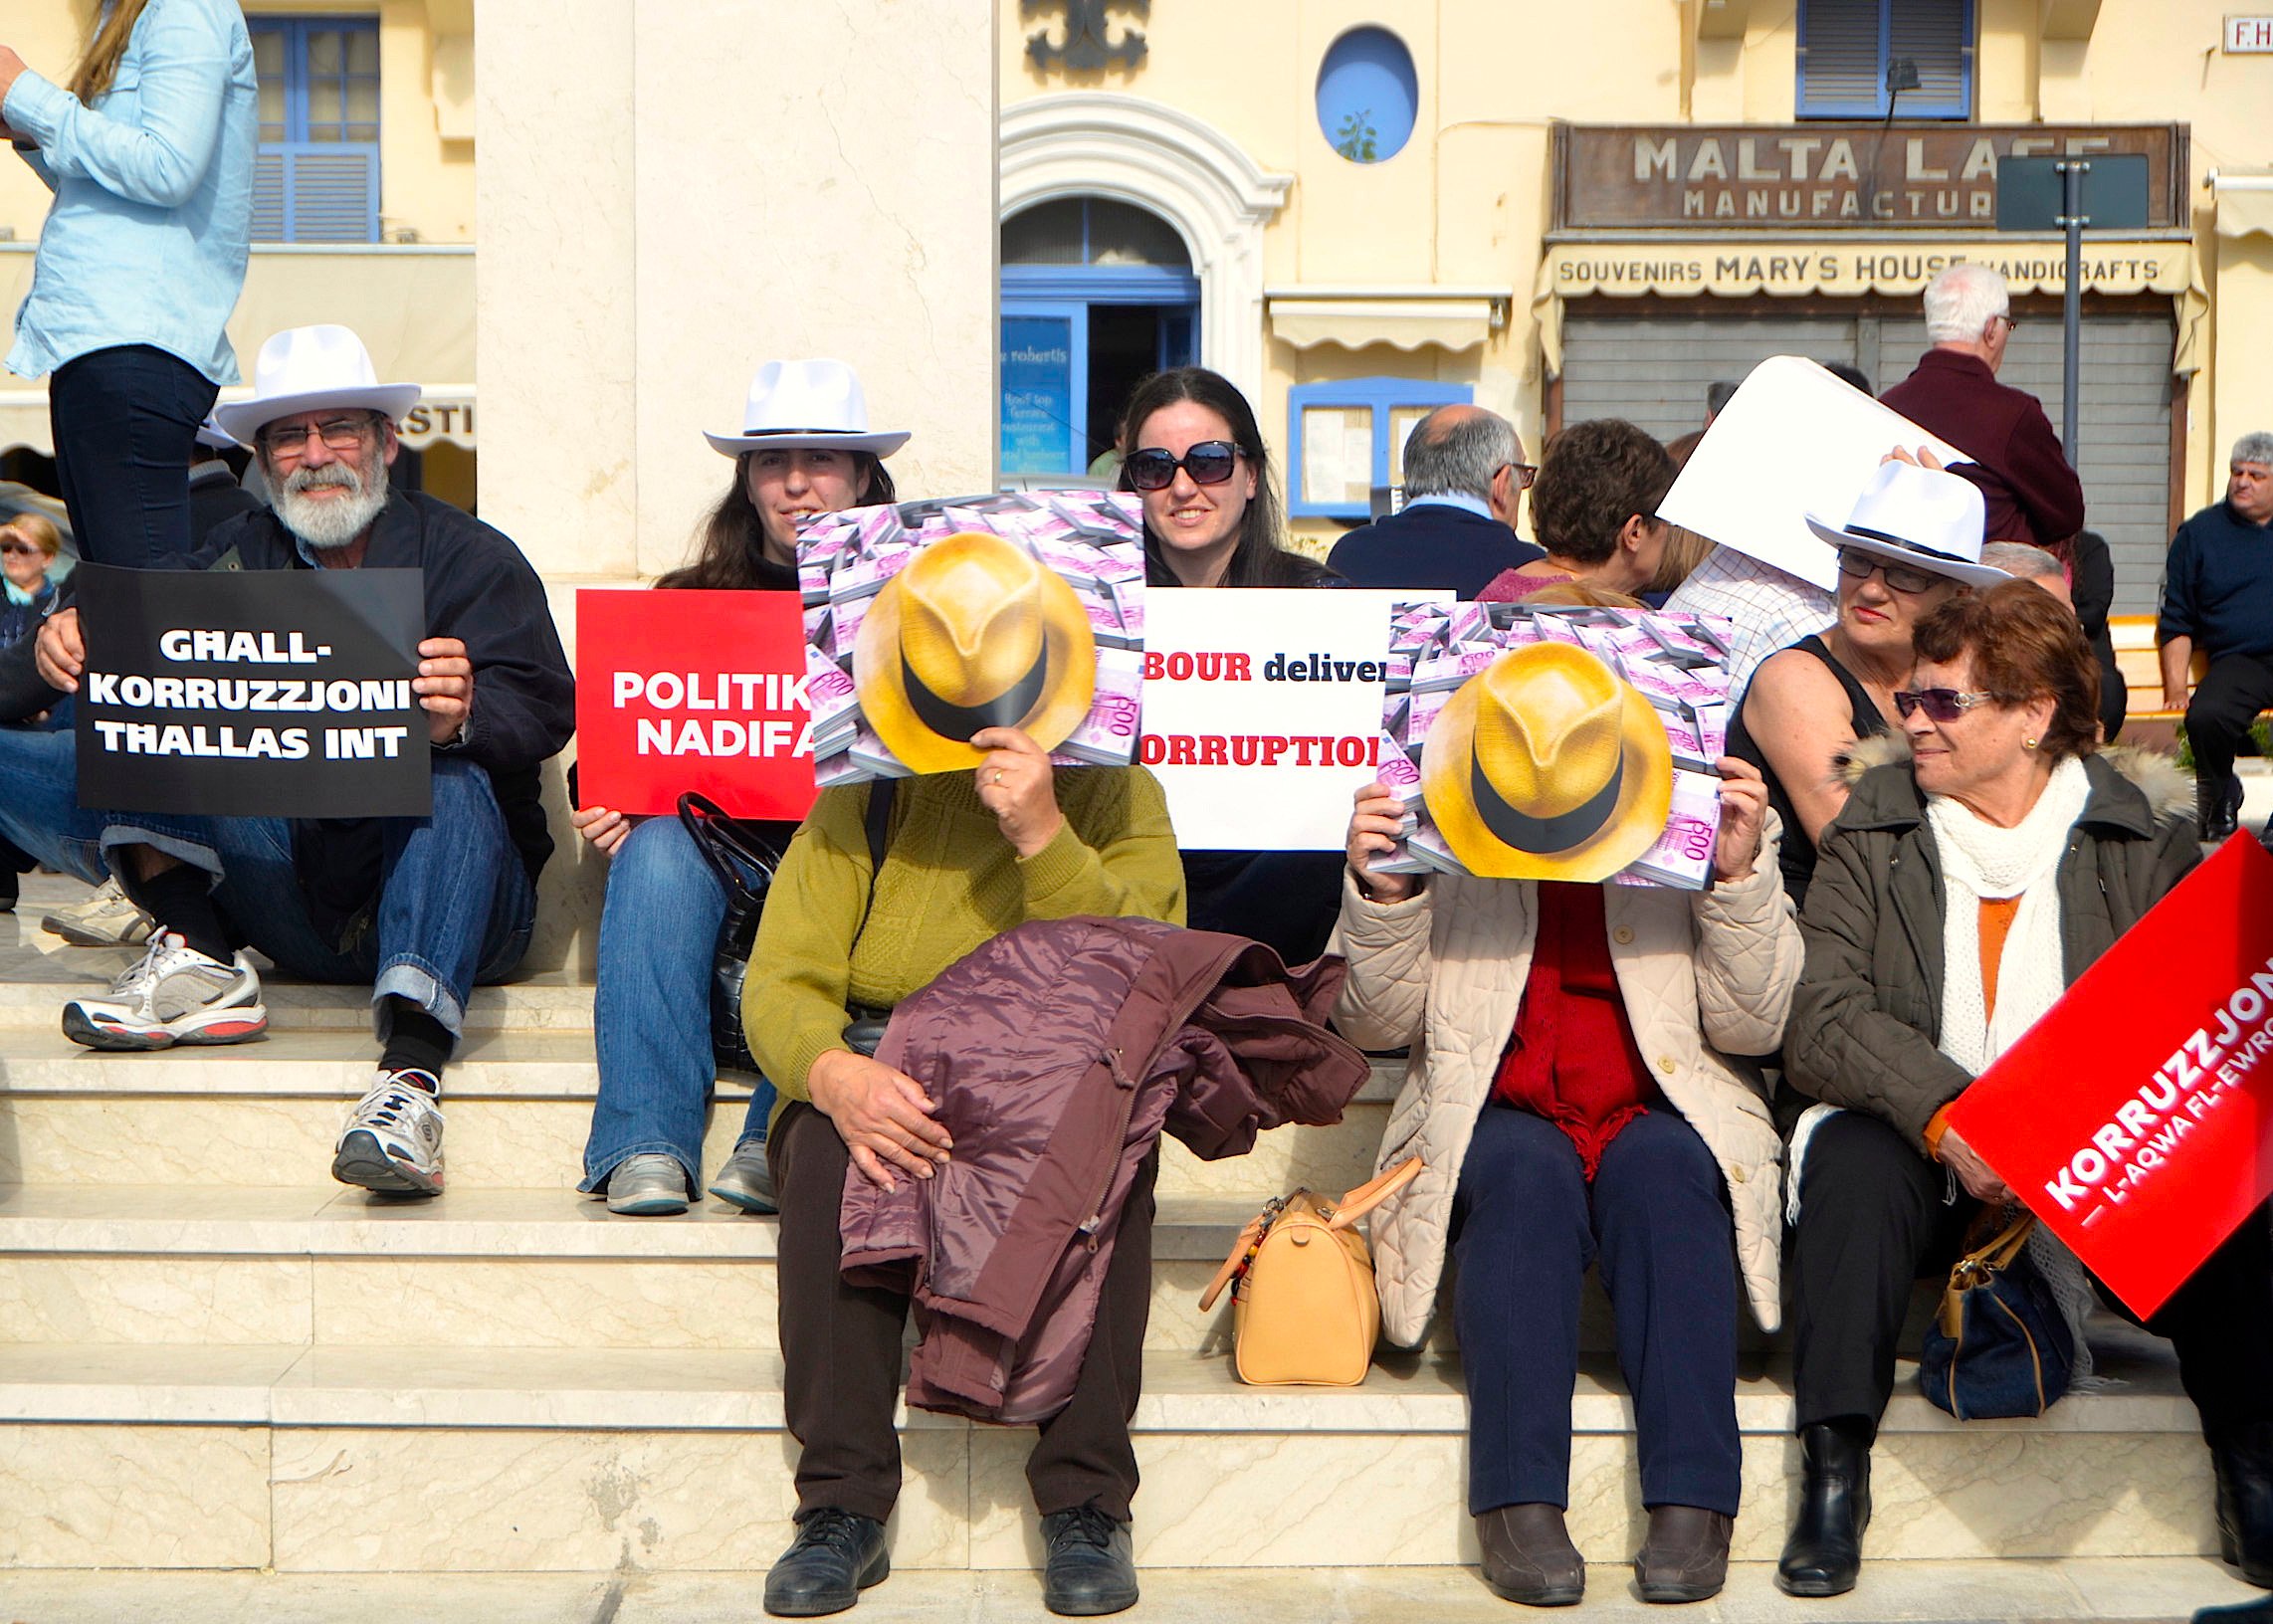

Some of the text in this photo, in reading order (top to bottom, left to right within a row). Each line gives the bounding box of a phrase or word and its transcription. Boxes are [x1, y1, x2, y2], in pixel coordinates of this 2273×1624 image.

[1633, 137, 1859, 180] MALTA
[1559, 261, 1702, 282] SOUVENIRS
[1715, 255, 1839, 282] MARY'S
[396, 404, 472, 435] STI
[1143, 652, 1252, 681] BOUR
[89, 672, 411, 712] KORRUZZJONI
[613, 672, 812, 711] POLITIK
[95, 720, 408, 759] TĦALLAS INT
[1682, 821, 1713, 861] 500
